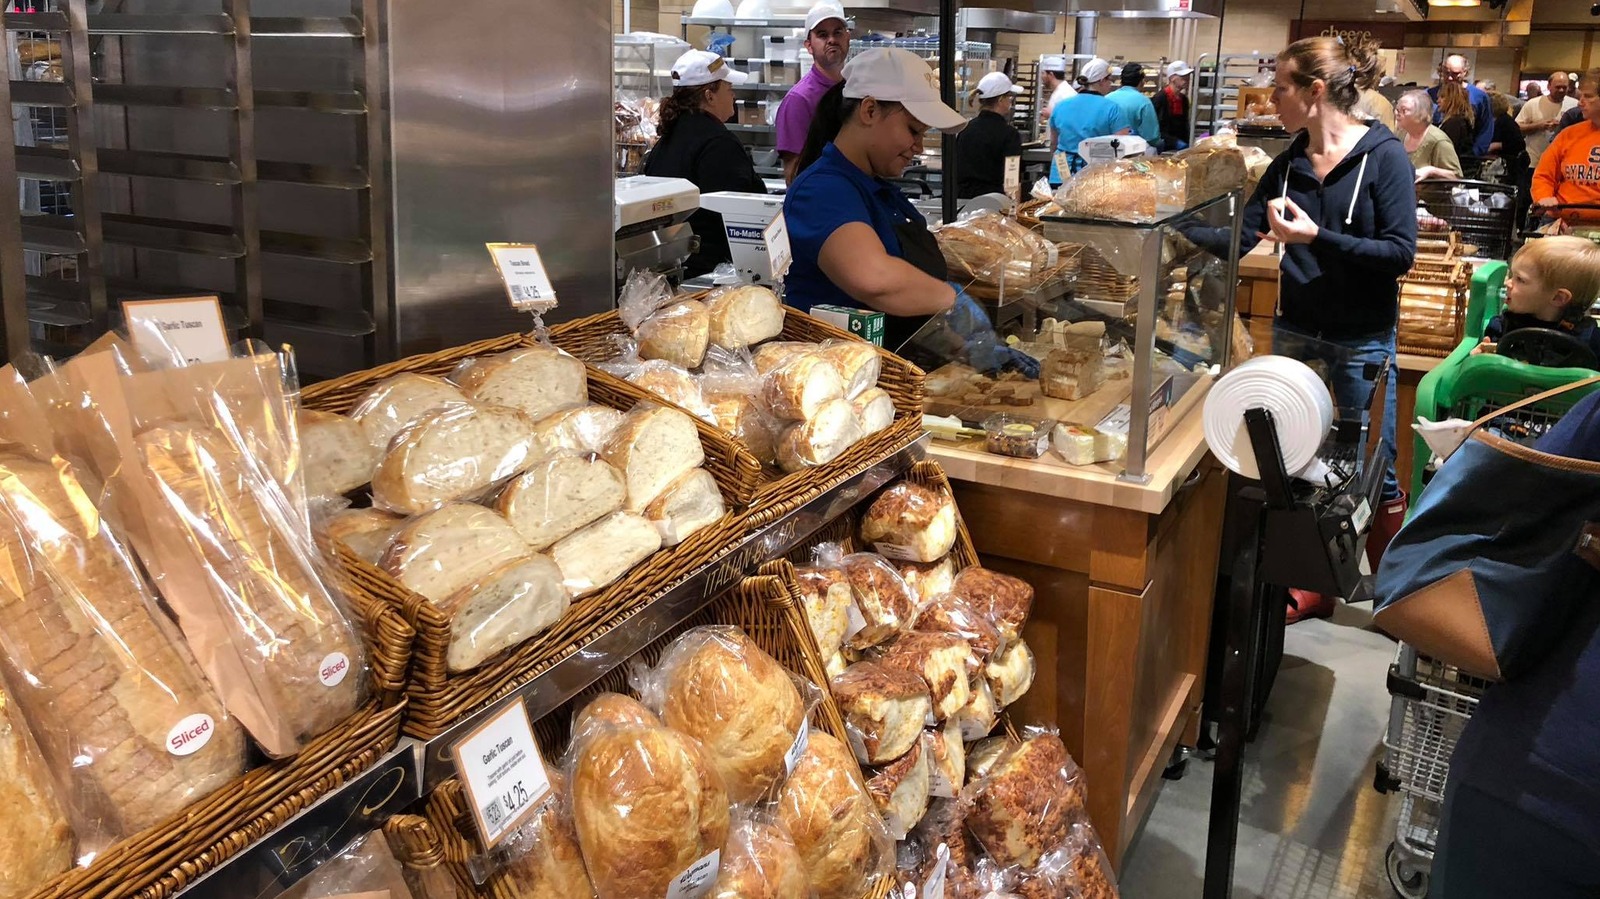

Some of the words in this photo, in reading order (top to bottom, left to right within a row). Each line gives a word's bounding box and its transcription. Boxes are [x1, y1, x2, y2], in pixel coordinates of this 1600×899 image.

[729, 229, 760, 238] Tie-Matic
[321, 658, 346, 680] Sliced
[171, 719, 209, 749] Sliced
[483, 748, 498, 765] Garlic
[496, 736, 513, 754] Tuscan
